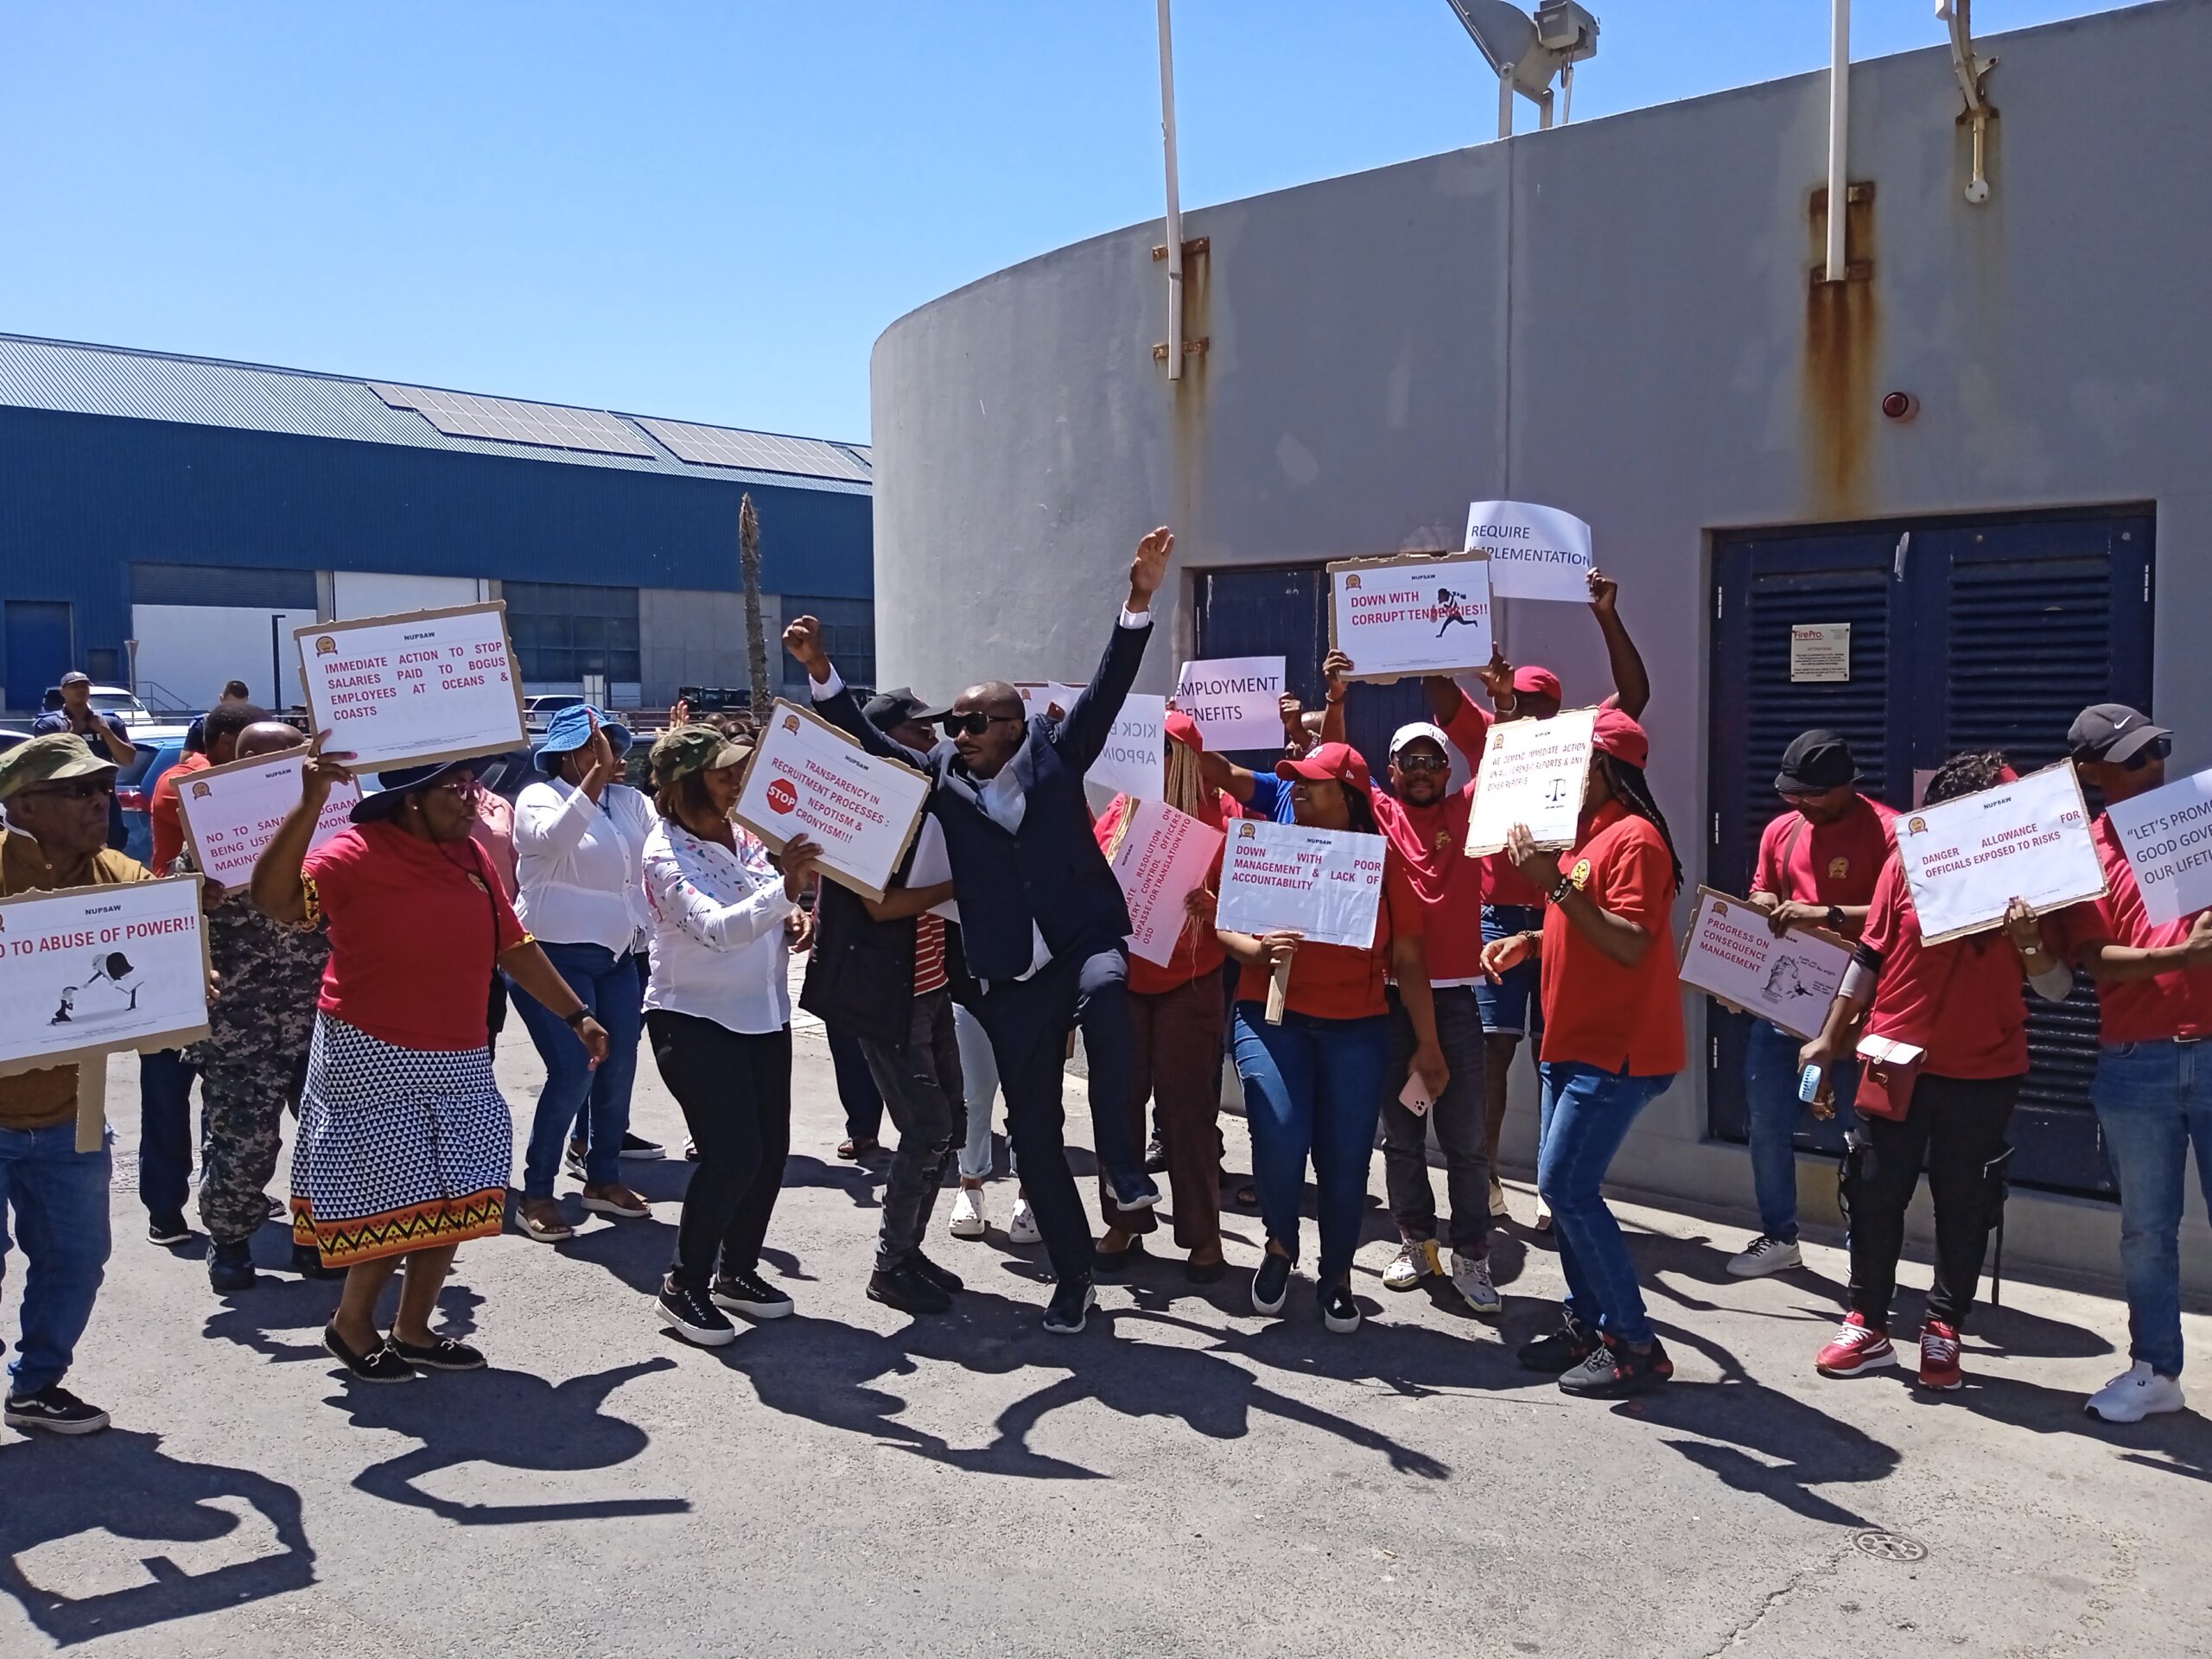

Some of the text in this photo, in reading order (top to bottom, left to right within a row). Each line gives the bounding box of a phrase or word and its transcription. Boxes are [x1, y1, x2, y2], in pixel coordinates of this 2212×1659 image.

[1471, 525, 1529, 538] REQUIRE
[1470, 547, 1590, 566] PLEMENTATION
[1351, 592, 1419, 607] DOWN WITH
[1352, 611, 1405, 626] CORRUPT
[404, 632, 435, 641] NUPSAW
[325, 642, 502, 674] IMMEDIATE ACTION TO STOP
[328, 658, 505, 690] SALARIES PAID TO BOGUS
[331, 672, 509, 705] EMPLOYEES AT OCEANS &
[334, 706, 377, 721] COASTS
[1177, 706, 1243, 721] ENEFITS
[1562, 742, 1586, 753] ACTION
[265, 769, 291, 779] NUPSAW
[805, 760, 880, 804] TRANSPARENCY IN
[768, 785, 796, 806] STOP
[772, 758, 830, 797] RECRUITMENT
[830, 790, 885, 824] PROCESSES
[1984, 797, 2012, 810] NUPSAW
[796, 809, 853, 843] CRONYISM!!!
[807, 797, 862, 831] NEPOTISM &
[207, 832, 224, 843] NO
[232, 826, 248, 837] TO
[211, 815, 350, 858] BEING USE MONE
[1137, 808, 1172, 878] RESOLUTION ON
[1922, 810, 2080, 865] DANGER ALLOWANCE FOR
[1141, 858, 1161, 893] CONTROL
[1160, 813, 1181, 849] OFFICERS
[1236, 846, 1381, 871] DOWN WITH POOR
[1925, 831, 2061, 878] OFFICIALS EXPOSED TO RISKS
[2137, 839, 2177, 862] GOOD
[1134, 818, 1191, 940] IMPASSE FOR TRANSLATION INTO
[1235, 859, 1380, 885] MANAGEMENT & LACK OF
[2145, 849, 2212, 884] OUR LIFETI
[1232, 873, 1313, 890] ACCOUNTABILITY
[86, 905, 122, 915] NUPSAW
[10, 940, 34, 956] TO
[39, 931, 95, 952] ABUSE
[100, 927, 120, 943] OF
[126, 916, 194, 939] POWER!!
[1144, 927, 1154, 944] OSD
[1703, 931, 1767, 963] CONSEQUENCE
[1707, 918, 1770, 949] PROGRESS ON
[1700, 941, 1761, 973] MANAGEMENT
